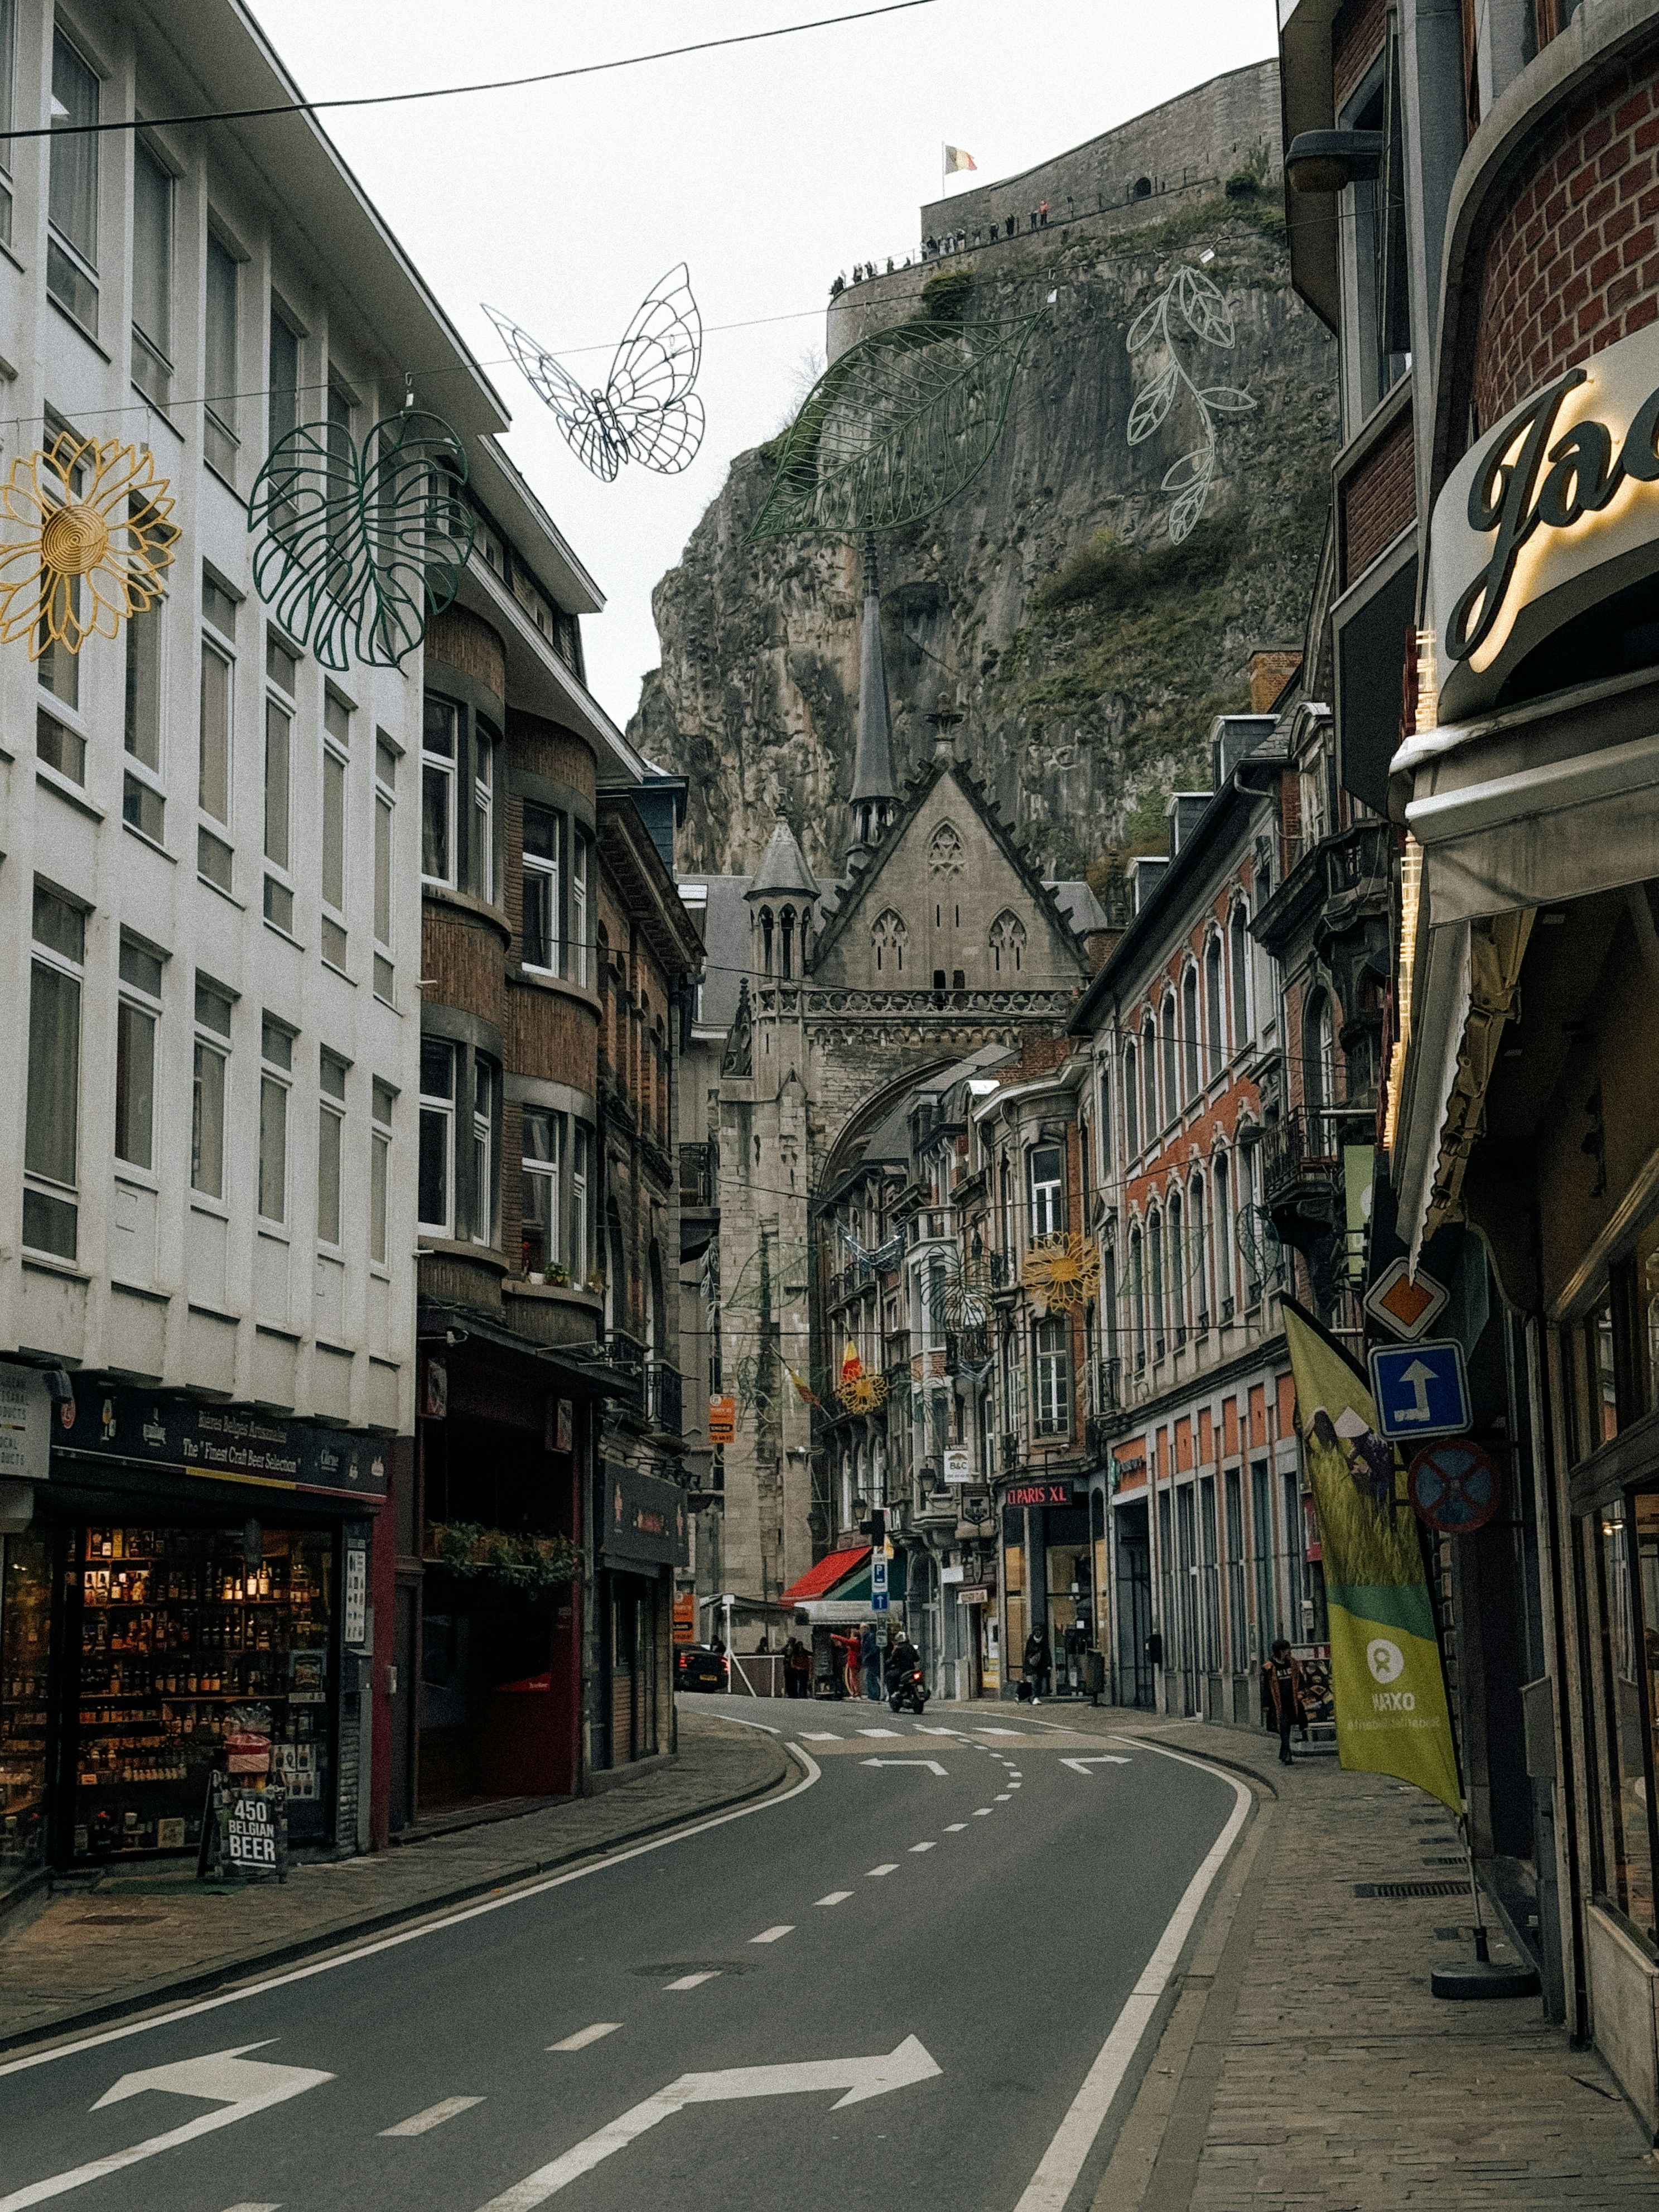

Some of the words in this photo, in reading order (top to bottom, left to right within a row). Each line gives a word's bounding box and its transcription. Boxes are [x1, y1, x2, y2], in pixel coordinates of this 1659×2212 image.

[183, 1437, 199, 1458] The
[228, 1445, 247, 1466] Craft
[248, 1449, 265, 1469] Beer
[1016, 1486, 1045, 1505] PARIS
[1049, 1485, 1068, 1502] XL
[234, 1800, 267, 1822] 450
[228, 1819, 275, 1838] BELGIAN
[229, 1834, 276, 1862] BEER
